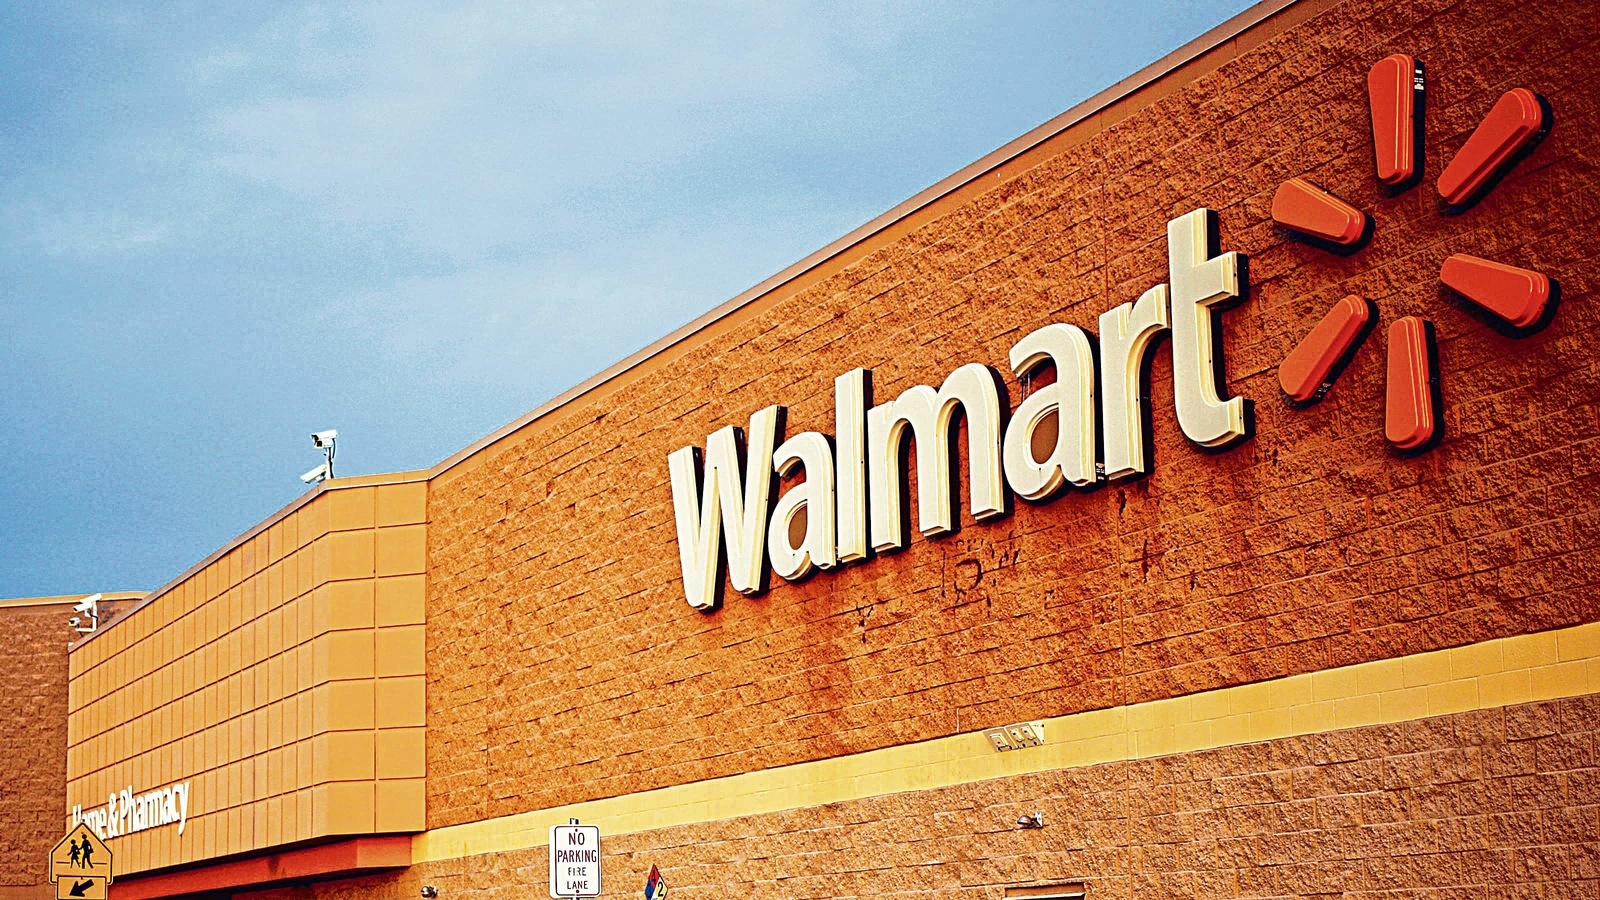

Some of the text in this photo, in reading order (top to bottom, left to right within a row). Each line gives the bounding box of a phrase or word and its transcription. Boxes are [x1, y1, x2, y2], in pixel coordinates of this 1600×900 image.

[668, 207, 1250, 610] Walmart
[108, 792, 119, 838] &
[120, 782, 190, 836] Pharmacy
[568, 832, 585, 846] NO
[557, 849, 597, 863] PARKING
[568, 866, 587, 877] FIRE
[566, 880, 589, 890] LANE
[657, 881, 664, 897] 2
